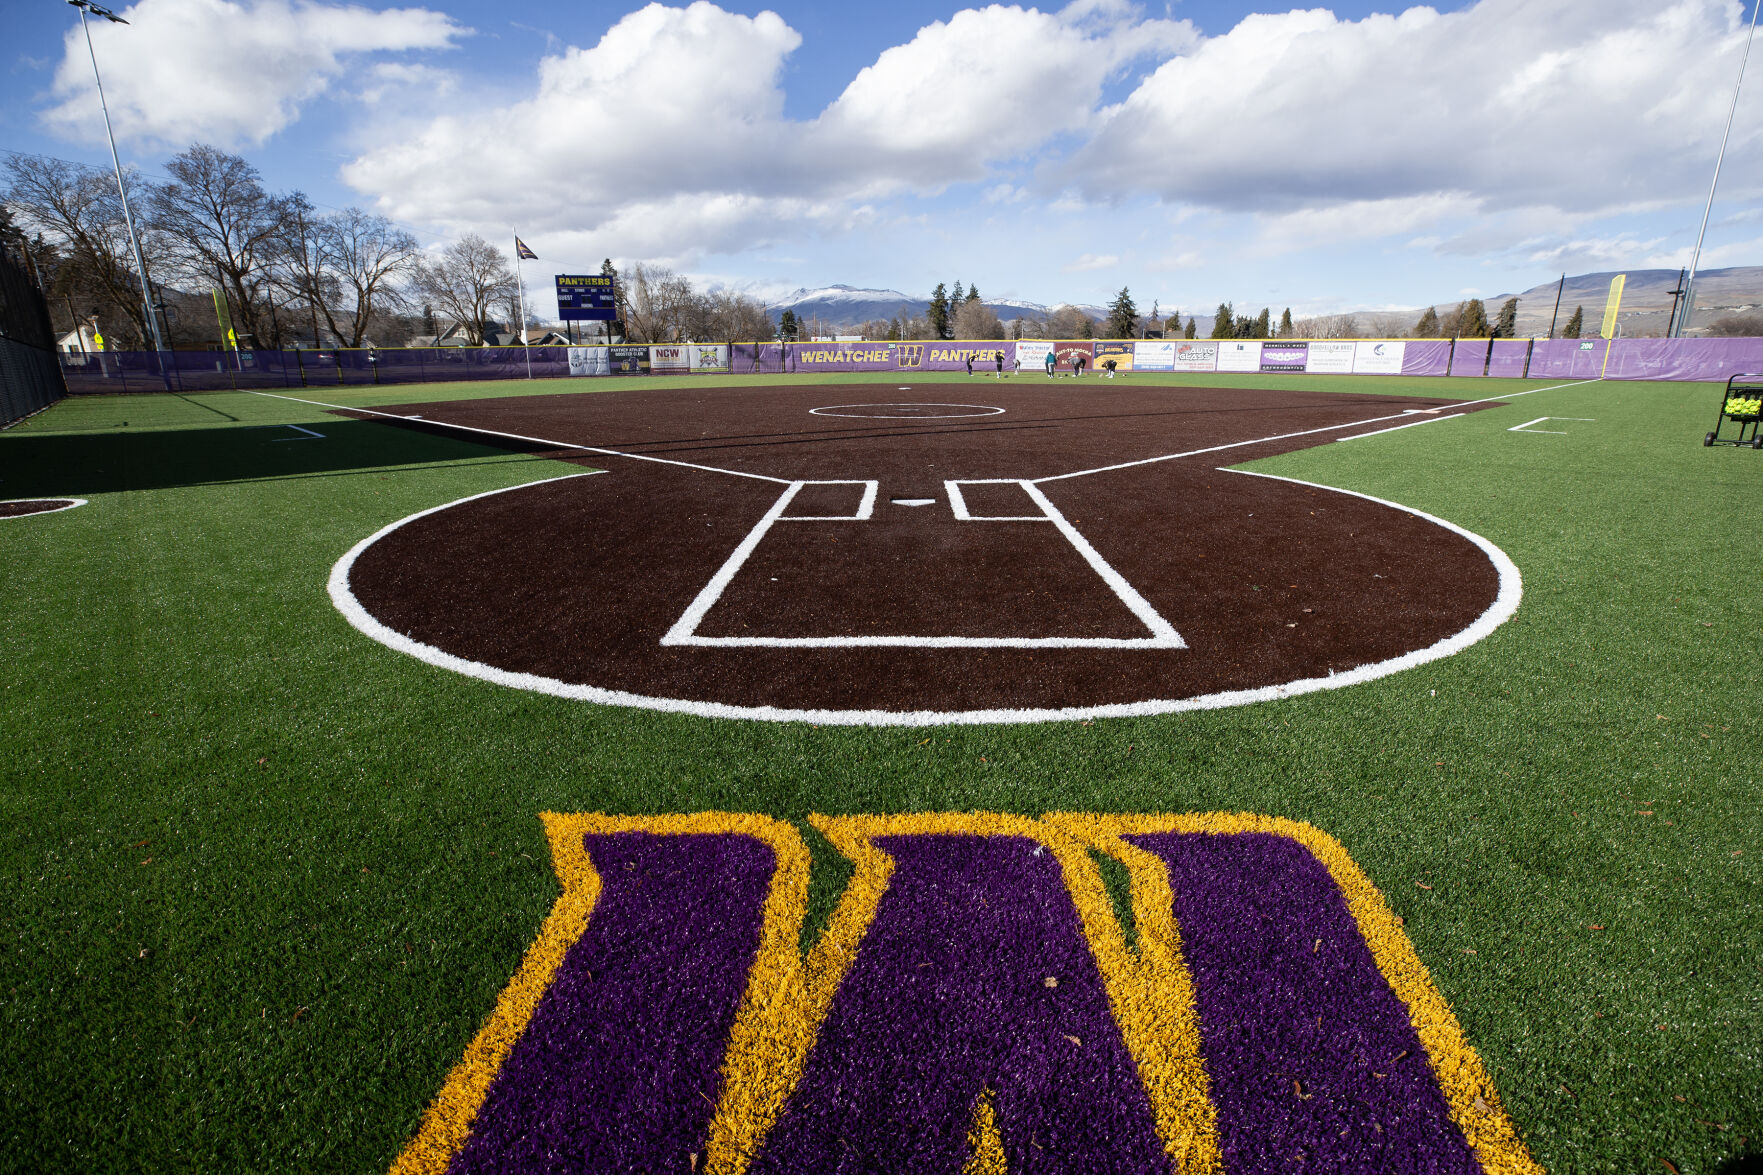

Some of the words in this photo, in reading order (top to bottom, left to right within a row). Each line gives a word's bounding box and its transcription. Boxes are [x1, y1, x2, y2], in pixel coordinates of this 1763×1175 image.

[559, 277, 610, 286] PANTHERS
[656, 348, 679, 358] NCW
[801, 350, 890, 363] WENATCHEE
